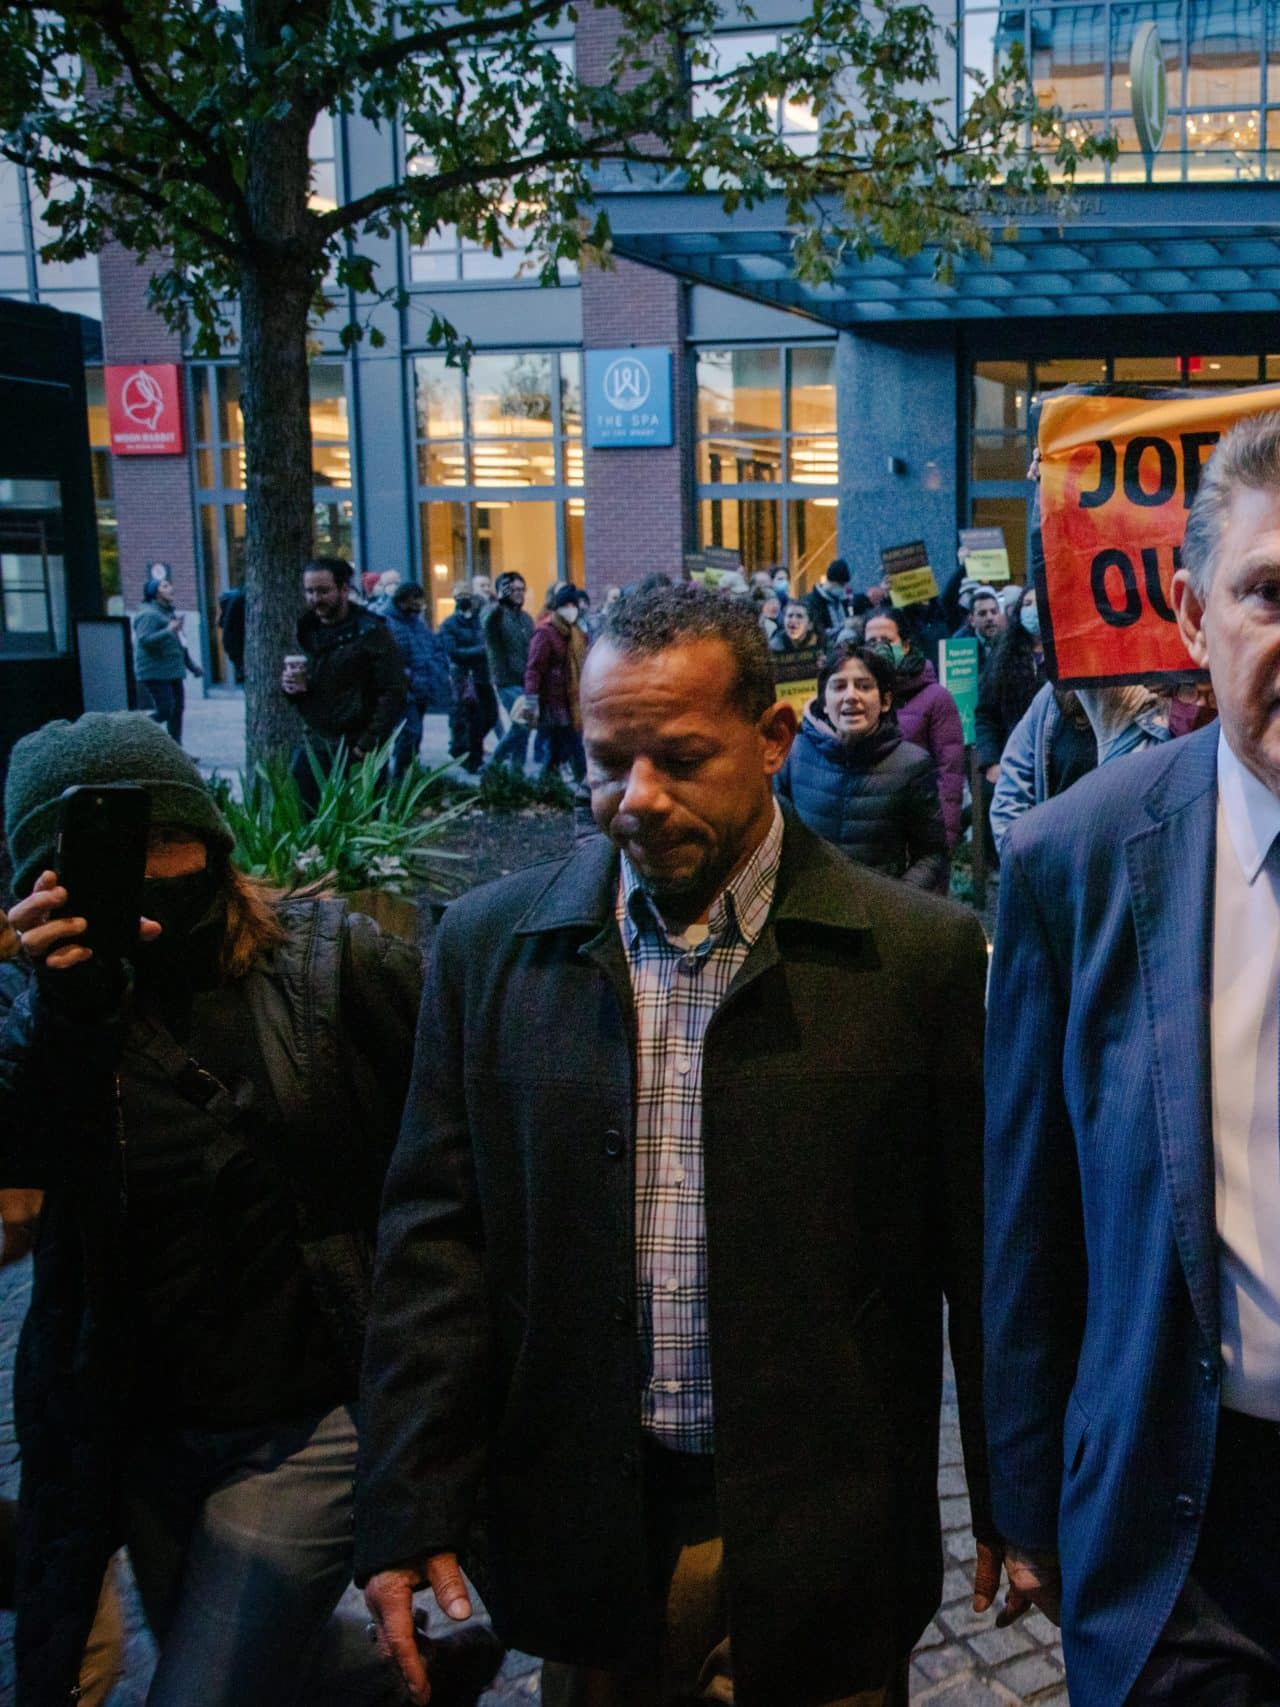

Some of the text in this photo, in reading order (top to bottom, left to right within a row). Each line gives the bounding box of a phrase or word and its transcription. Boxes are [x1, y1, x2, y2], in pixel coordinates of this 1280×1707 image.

[597, 413, 660, 427] THE SPA
[1090, 546, 1182, 627] OU
